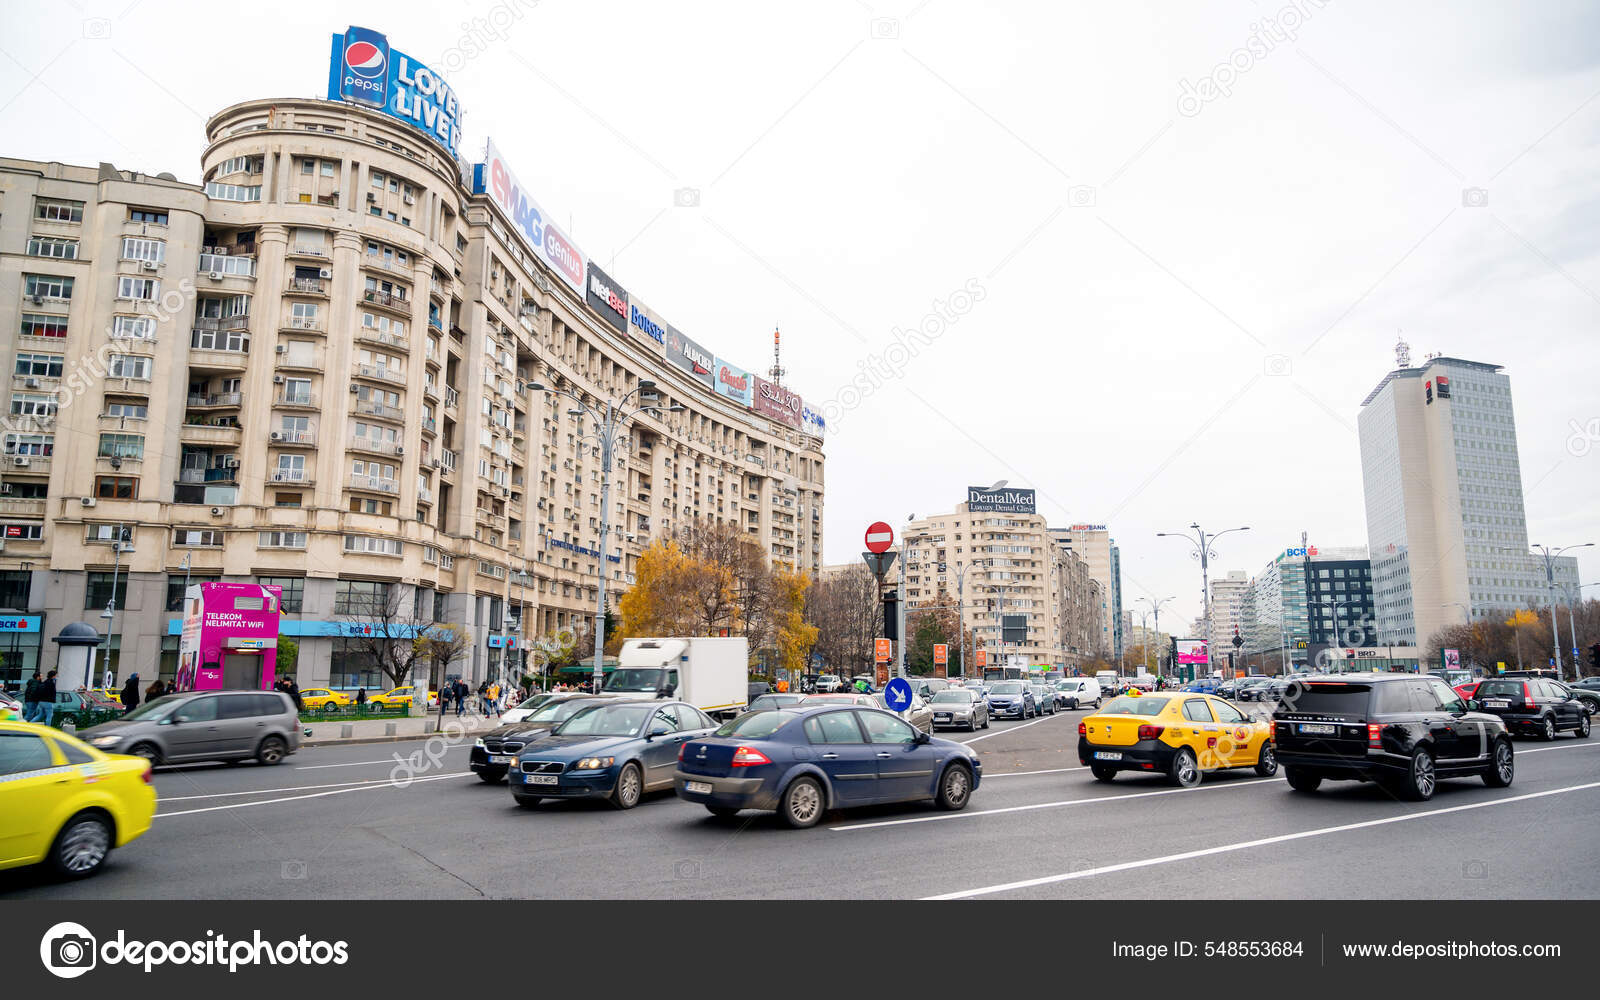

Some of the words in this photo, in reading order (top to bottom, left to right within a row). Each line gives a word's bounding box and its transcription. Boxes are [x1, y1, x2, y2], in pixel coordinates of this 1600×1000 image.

[344, 75, 384, 92] pepsi
[398, 56, 456, 119] LOVE
[396, 86, 450, 141] LIVE
[491, 157, 543, 247] eMAG
[548, 234, 580, 275] genius
[970, 490, 1034, 505] DentalMed
[970, 503, 993, 512] Luxury
[995, 504, 1016, 512] Dental
[1017, 504, 1035, 513] Clinic
[1286, 548, 1307, 557] BCR
[205, 619, 247, 628] NELIMITAT
[206, 612, 242, 620] TELEKOM
